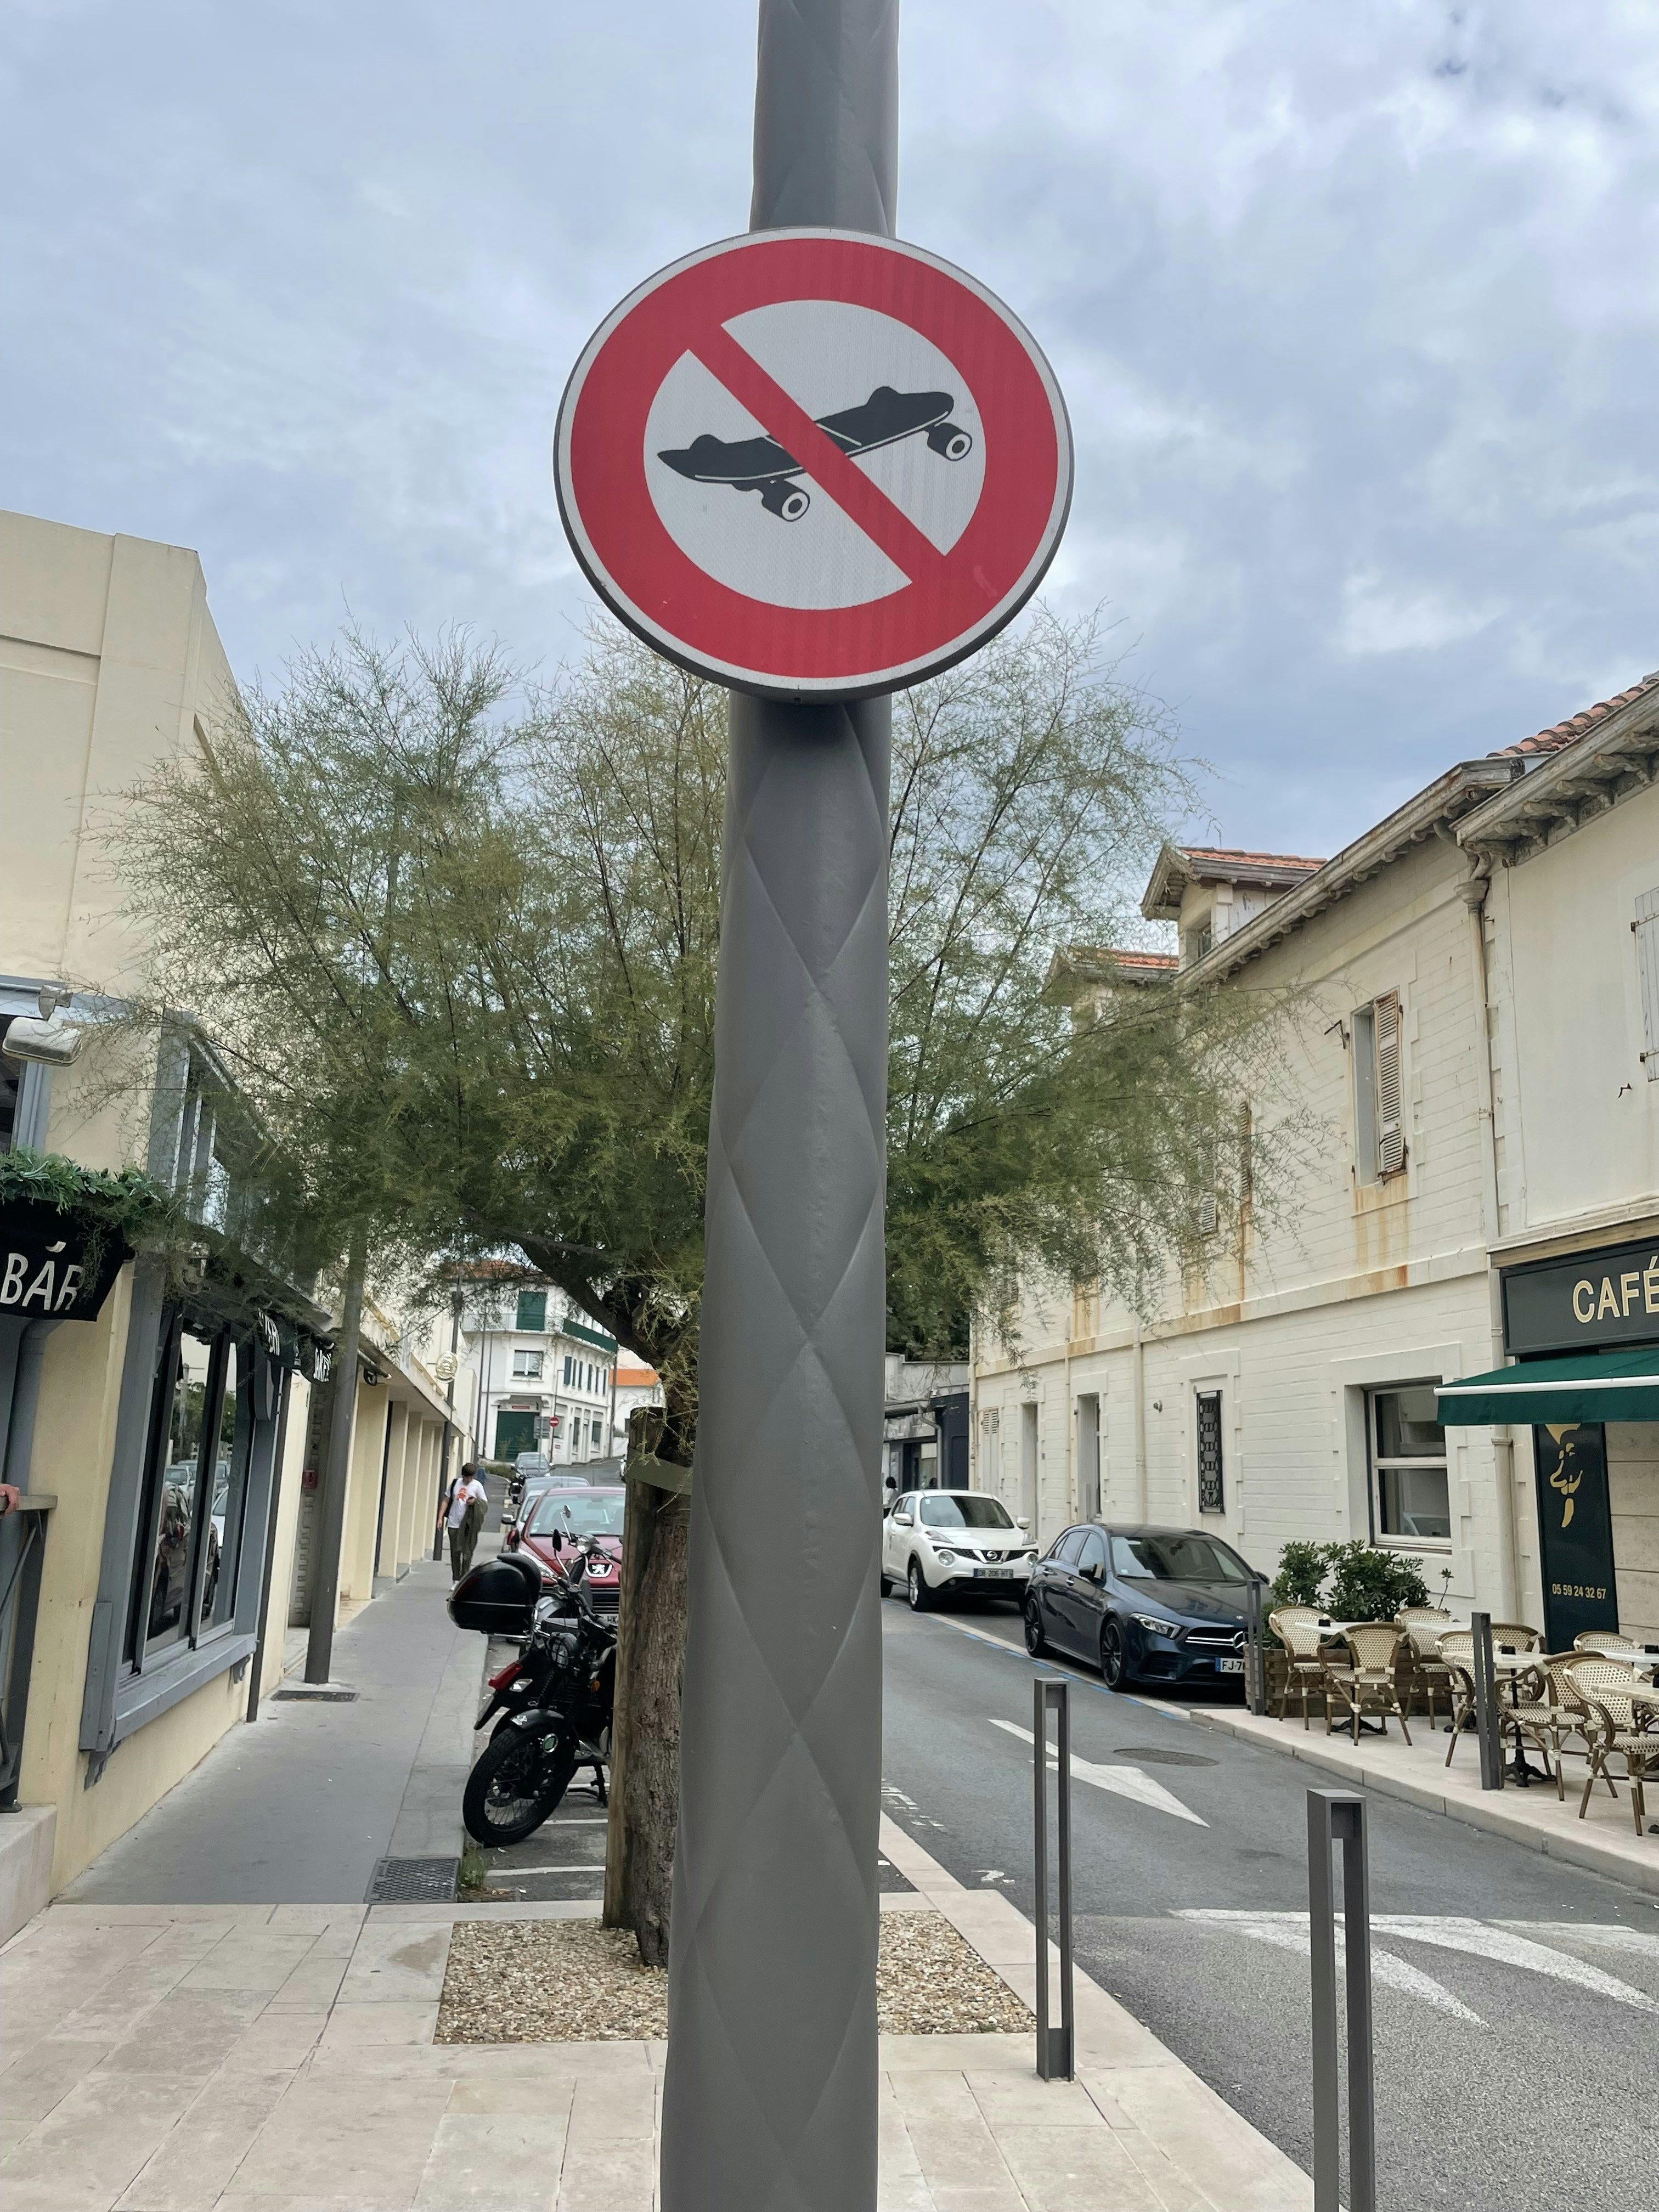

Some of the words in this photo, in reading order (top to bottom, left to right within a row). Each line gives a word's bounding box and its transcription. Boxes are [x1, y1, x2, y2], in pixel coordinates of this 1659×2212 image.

[1573, 1255, 1659, 1323] CAFÉ
[1552, 1583, 1561, 1594] 05
[1563, 1584, 1572, 1596] 59
[1574, 1585, 1583, 1597] 24
[1585, 1587, 1595, 1598] 32
[1596, 1588, 1606, 1599] 67
